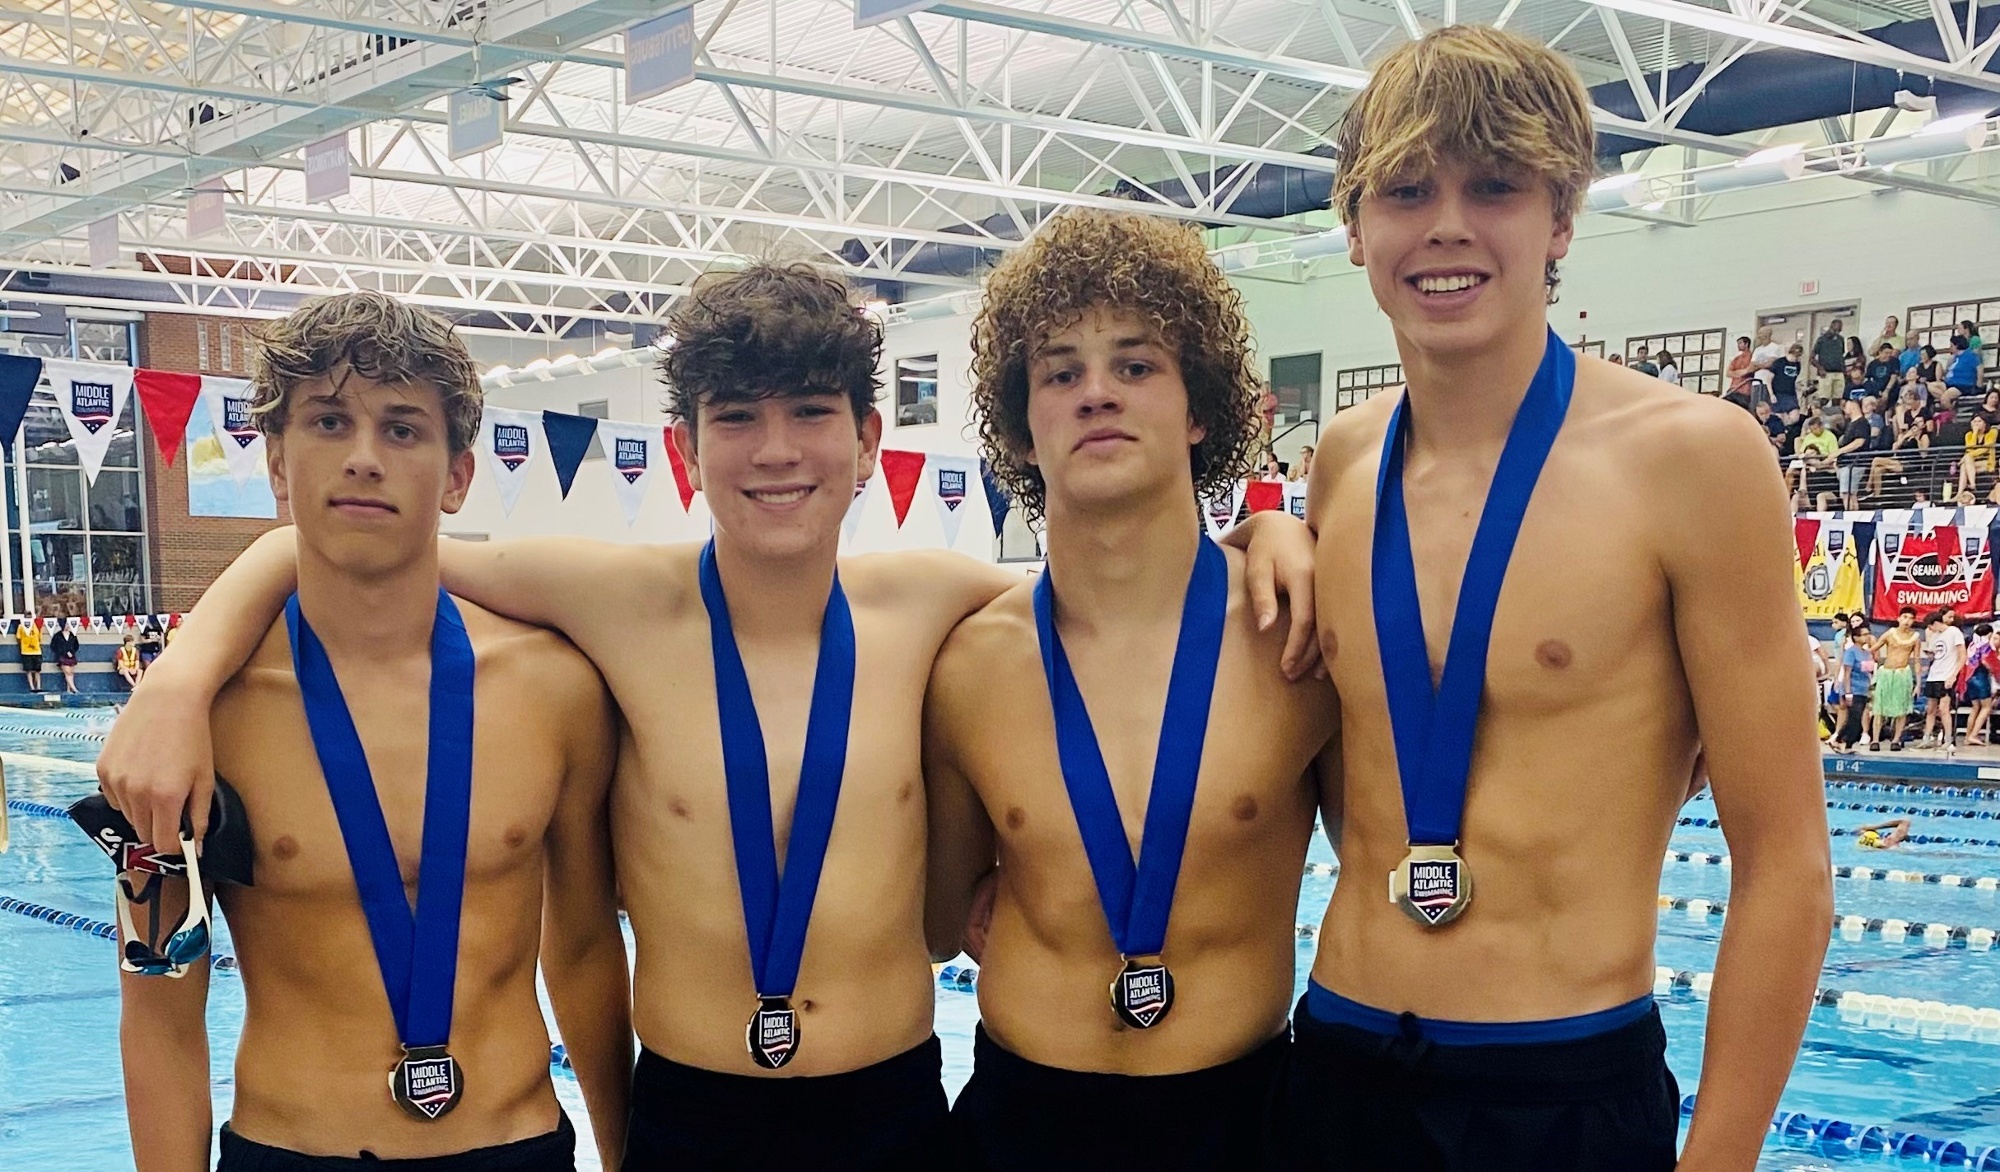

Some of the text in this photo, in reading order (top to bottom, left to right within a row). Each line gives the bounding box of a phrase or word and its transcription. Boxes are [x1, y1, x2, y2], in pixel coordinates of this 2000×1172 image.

[75, 384, 110, 399] MIDDLE
[76, 397, 110, 407] ATLANTIC
[227, 400, 252, 413] MIDD
[497, 427, 526, 440] MIDDLE
[497, 438, 527, 447] ATLANTIC
[618, 440, 644, 454] MIDDLE
[618, 451, 645, 461] ATLANTIC
[1912, 564, 1958, 576] SEAHAKS
[1897, 589, 1969, 605] SWIMMING
[1413, 866, 1451, 879] MIDDLE
[1413, 879, 1453, 890] ATLANTIC
[1414, 887, 1453, 897] SWIMMING
[1129, 974, 1159, 989] MIDDLE
[1129, 985, 1161, 999] ATLANTIC
[763, 1016, 790, 1029] MIDDLE
[763, 1027, 790, 1038] ATLANTIC
[411, 1063, 446, 1079] MIDDLE
[412, 1076, 449, 1089] ATLANTIC
[412, 1084, 449, 1096] SWIMMING
